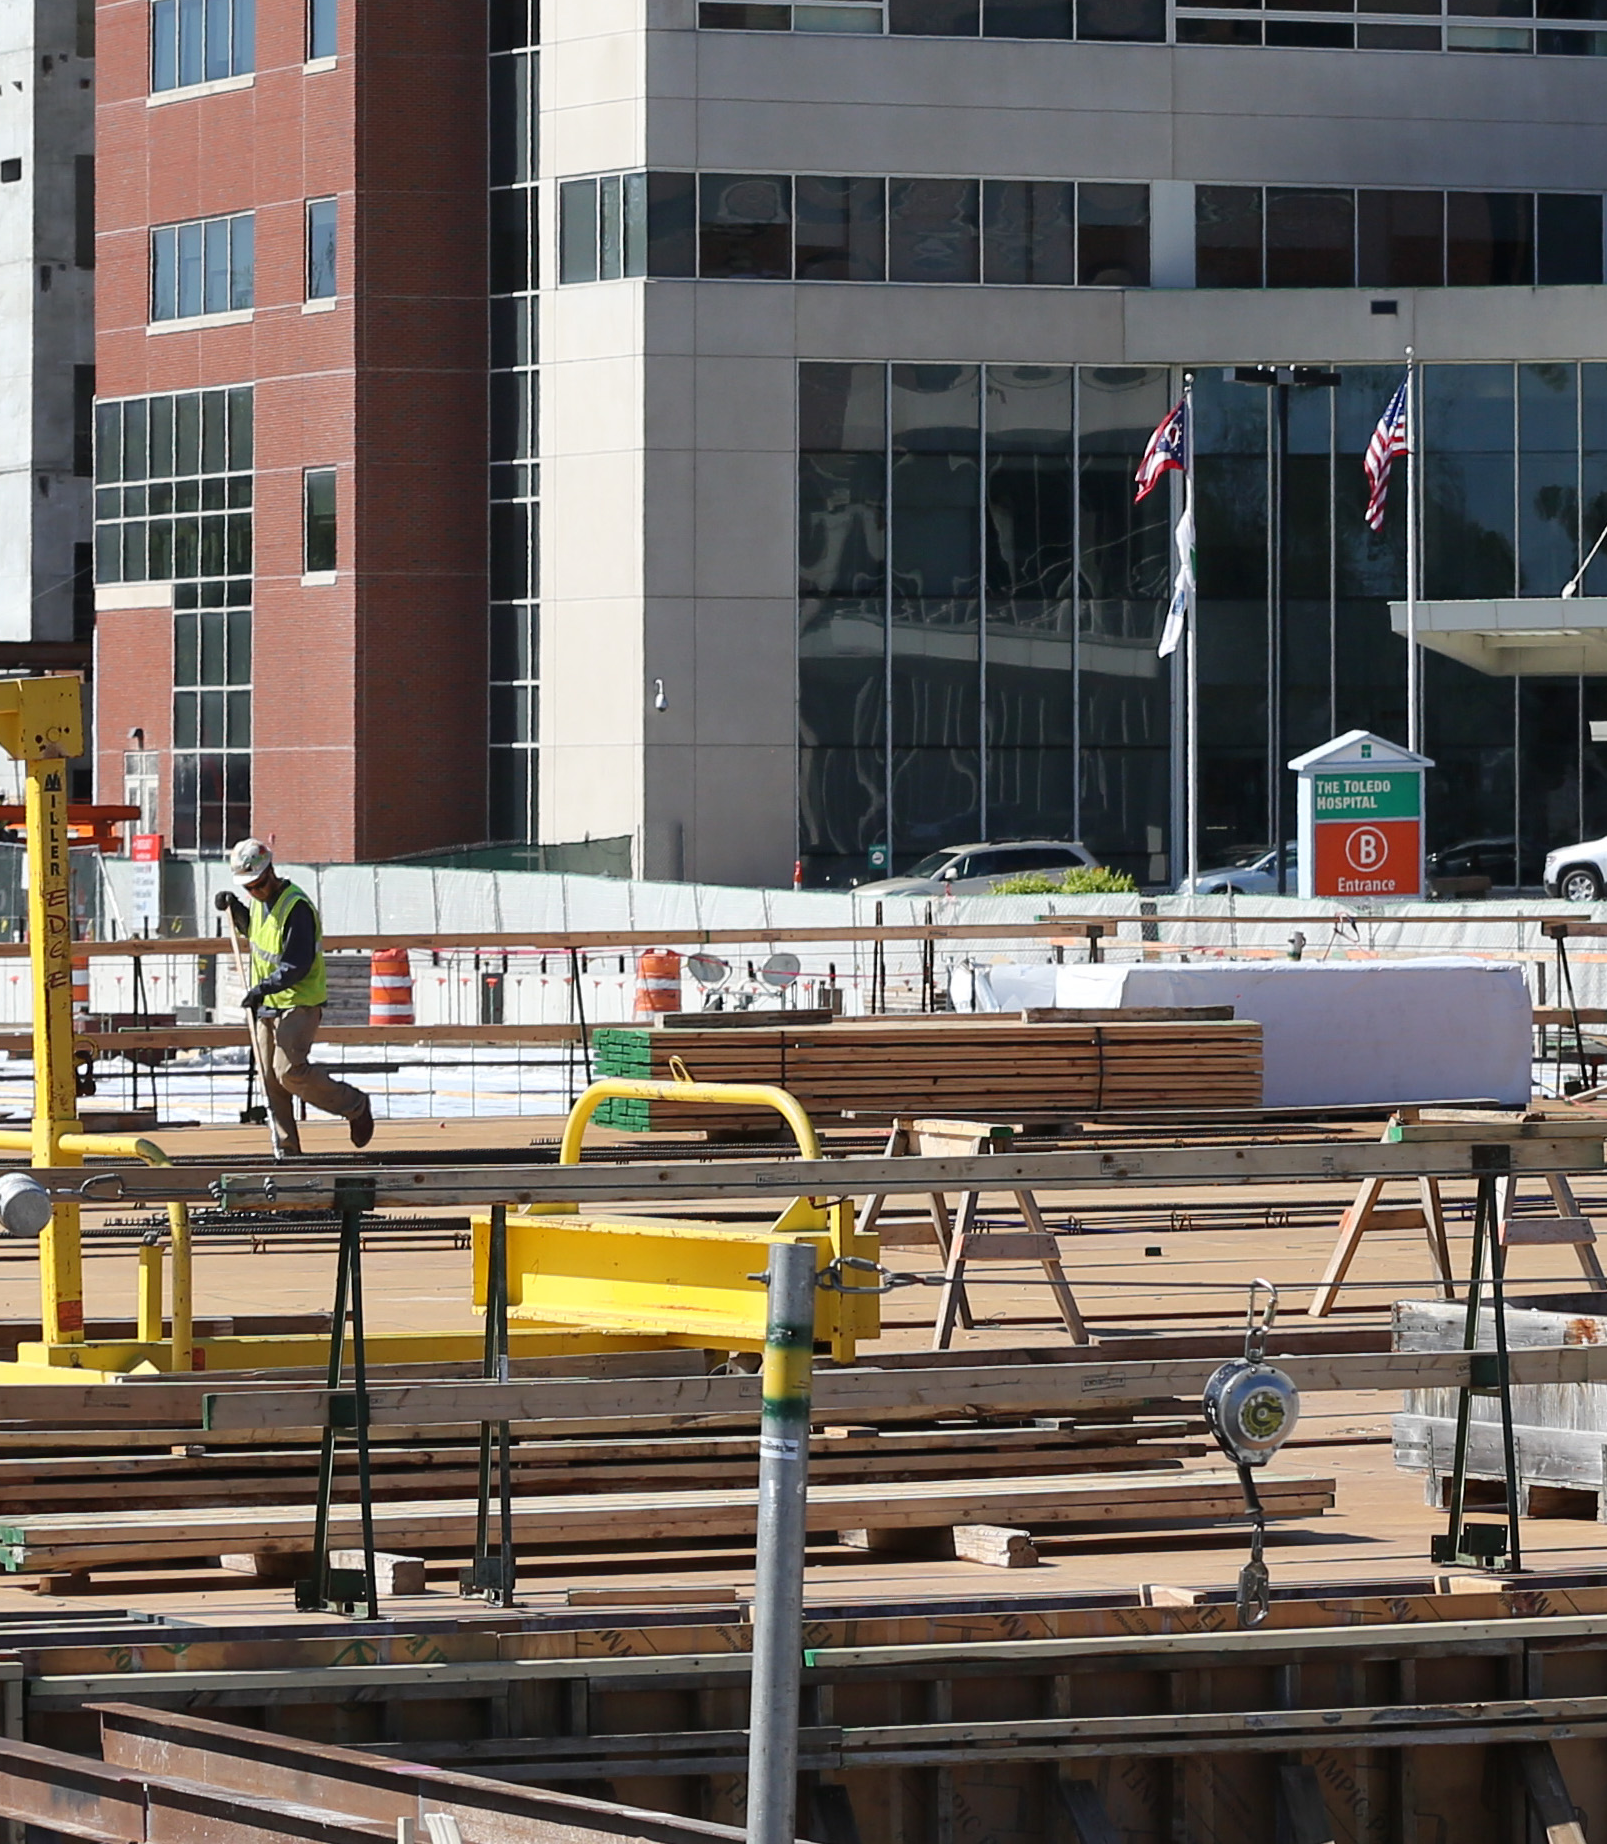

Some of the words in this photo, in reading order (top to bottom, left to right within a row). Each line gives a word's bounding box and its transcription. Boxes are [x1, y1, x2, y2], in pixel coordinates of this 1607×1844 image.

[1316, 780, 1340, 794] THE
[1344, 780, 1391, 794] TOLEDO
[1316, 796, 1378, 810] HOSPITAL
[44, 772, 63, 877] MILLER
[1359, 835, 1377, 865] B
[1337, 877, 1396, 893] Entrance
